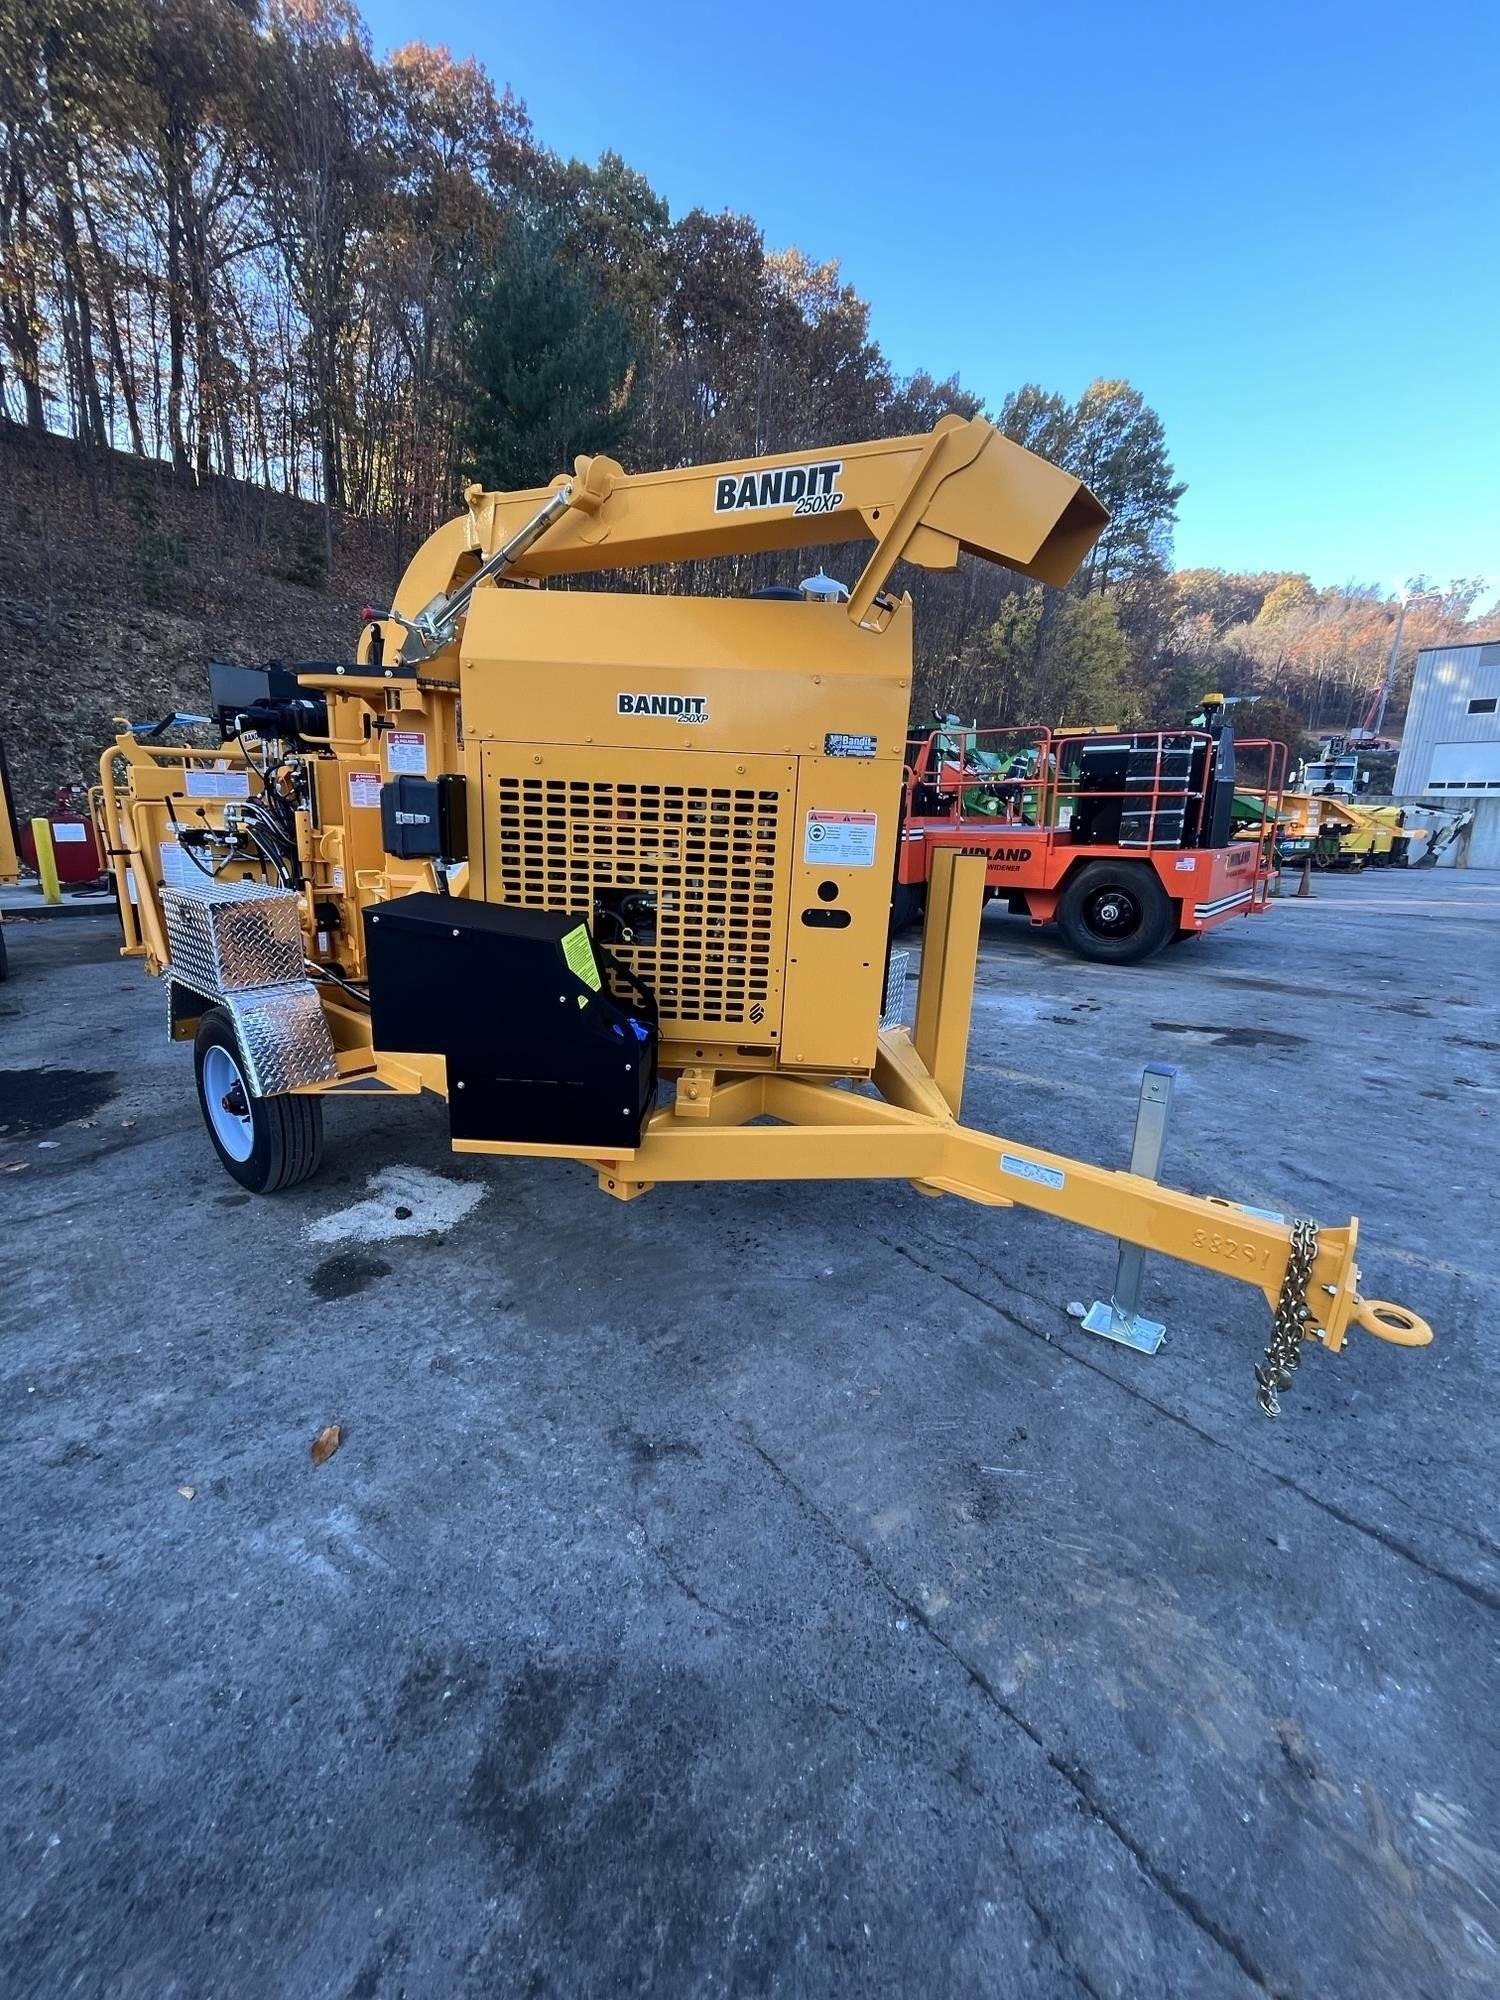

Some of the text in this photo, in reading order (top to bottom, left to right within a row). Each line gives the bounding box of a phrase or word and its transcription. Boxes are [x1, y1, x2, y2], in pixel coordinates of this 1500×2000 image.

[716, 464, 841, 510] BANDIT
[794, 493, 843, 514] 250XP
[619, 694, 705, 715] BANDIT
[677, 713, 709, 723] 250XP
[842, 735, 872, 746] Bandit
[987, 864, 1020, 872] WIDENER
[1192, 1228, 1271, 1270] 88291
